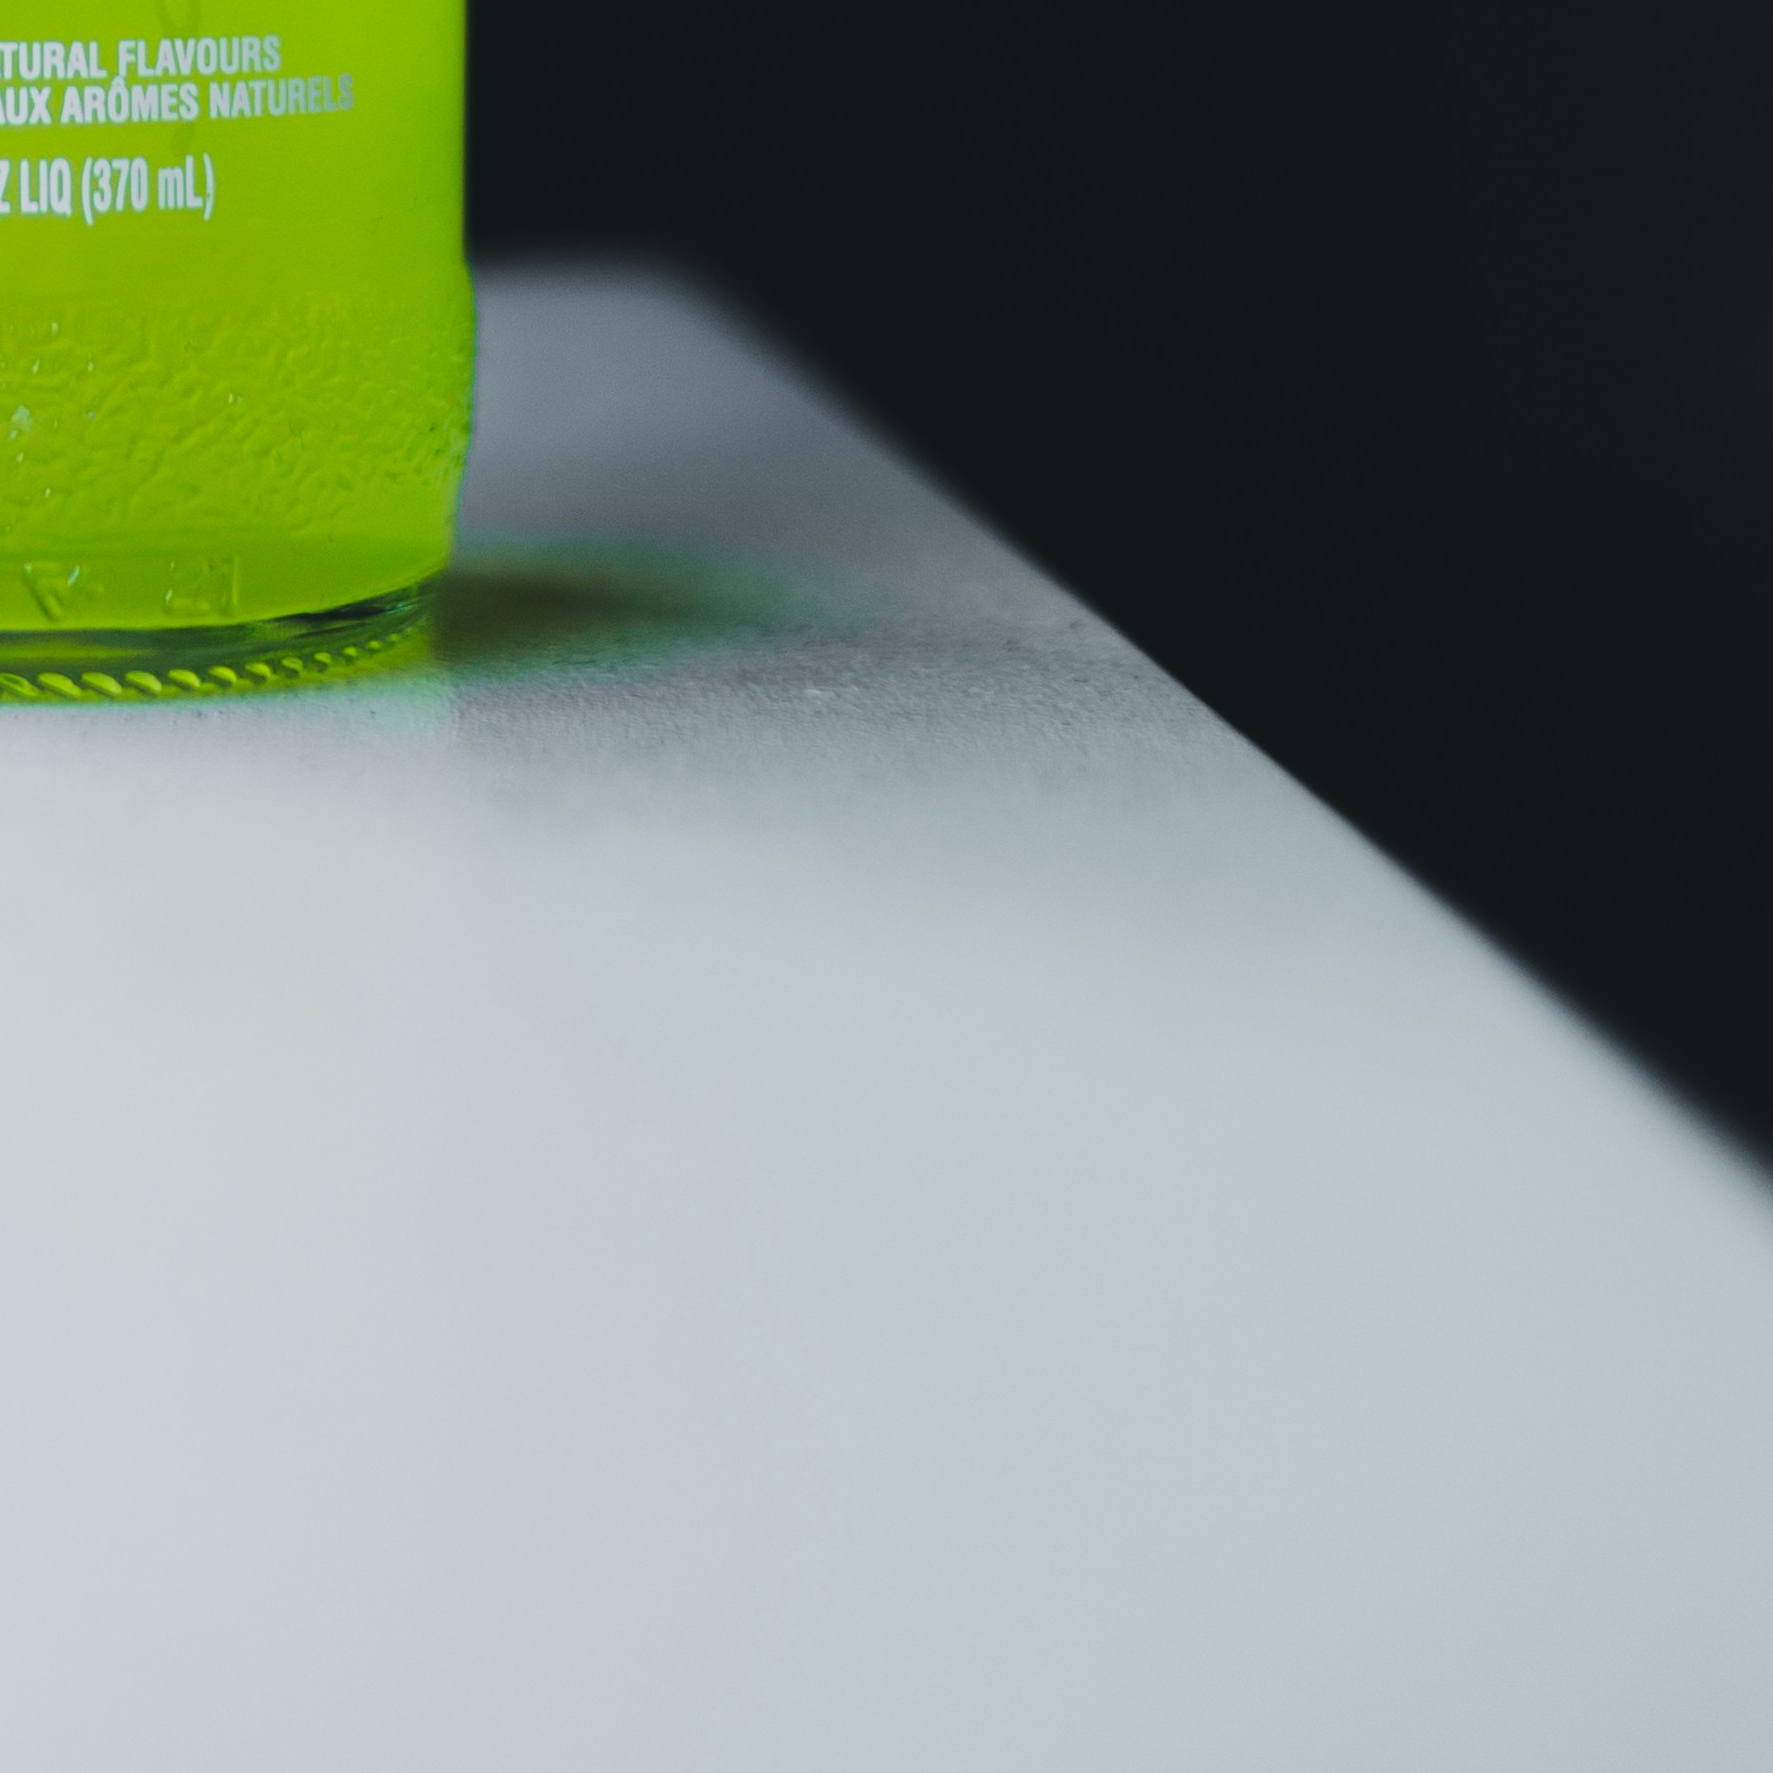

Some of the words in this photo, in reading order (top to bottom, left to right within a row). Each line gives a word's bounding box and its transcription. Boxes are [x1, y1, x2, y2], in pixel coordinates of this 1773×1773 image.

[115, 35, 281, 77] FLAVOURS
[59, 77, 200, 124] ARÔMES
[209, 74, 354, 120] NATURELS
[21, 157, 73, 217] LIQ
[81, 156, 149, 224] (370
[158, 153, 215, 220] mL)
